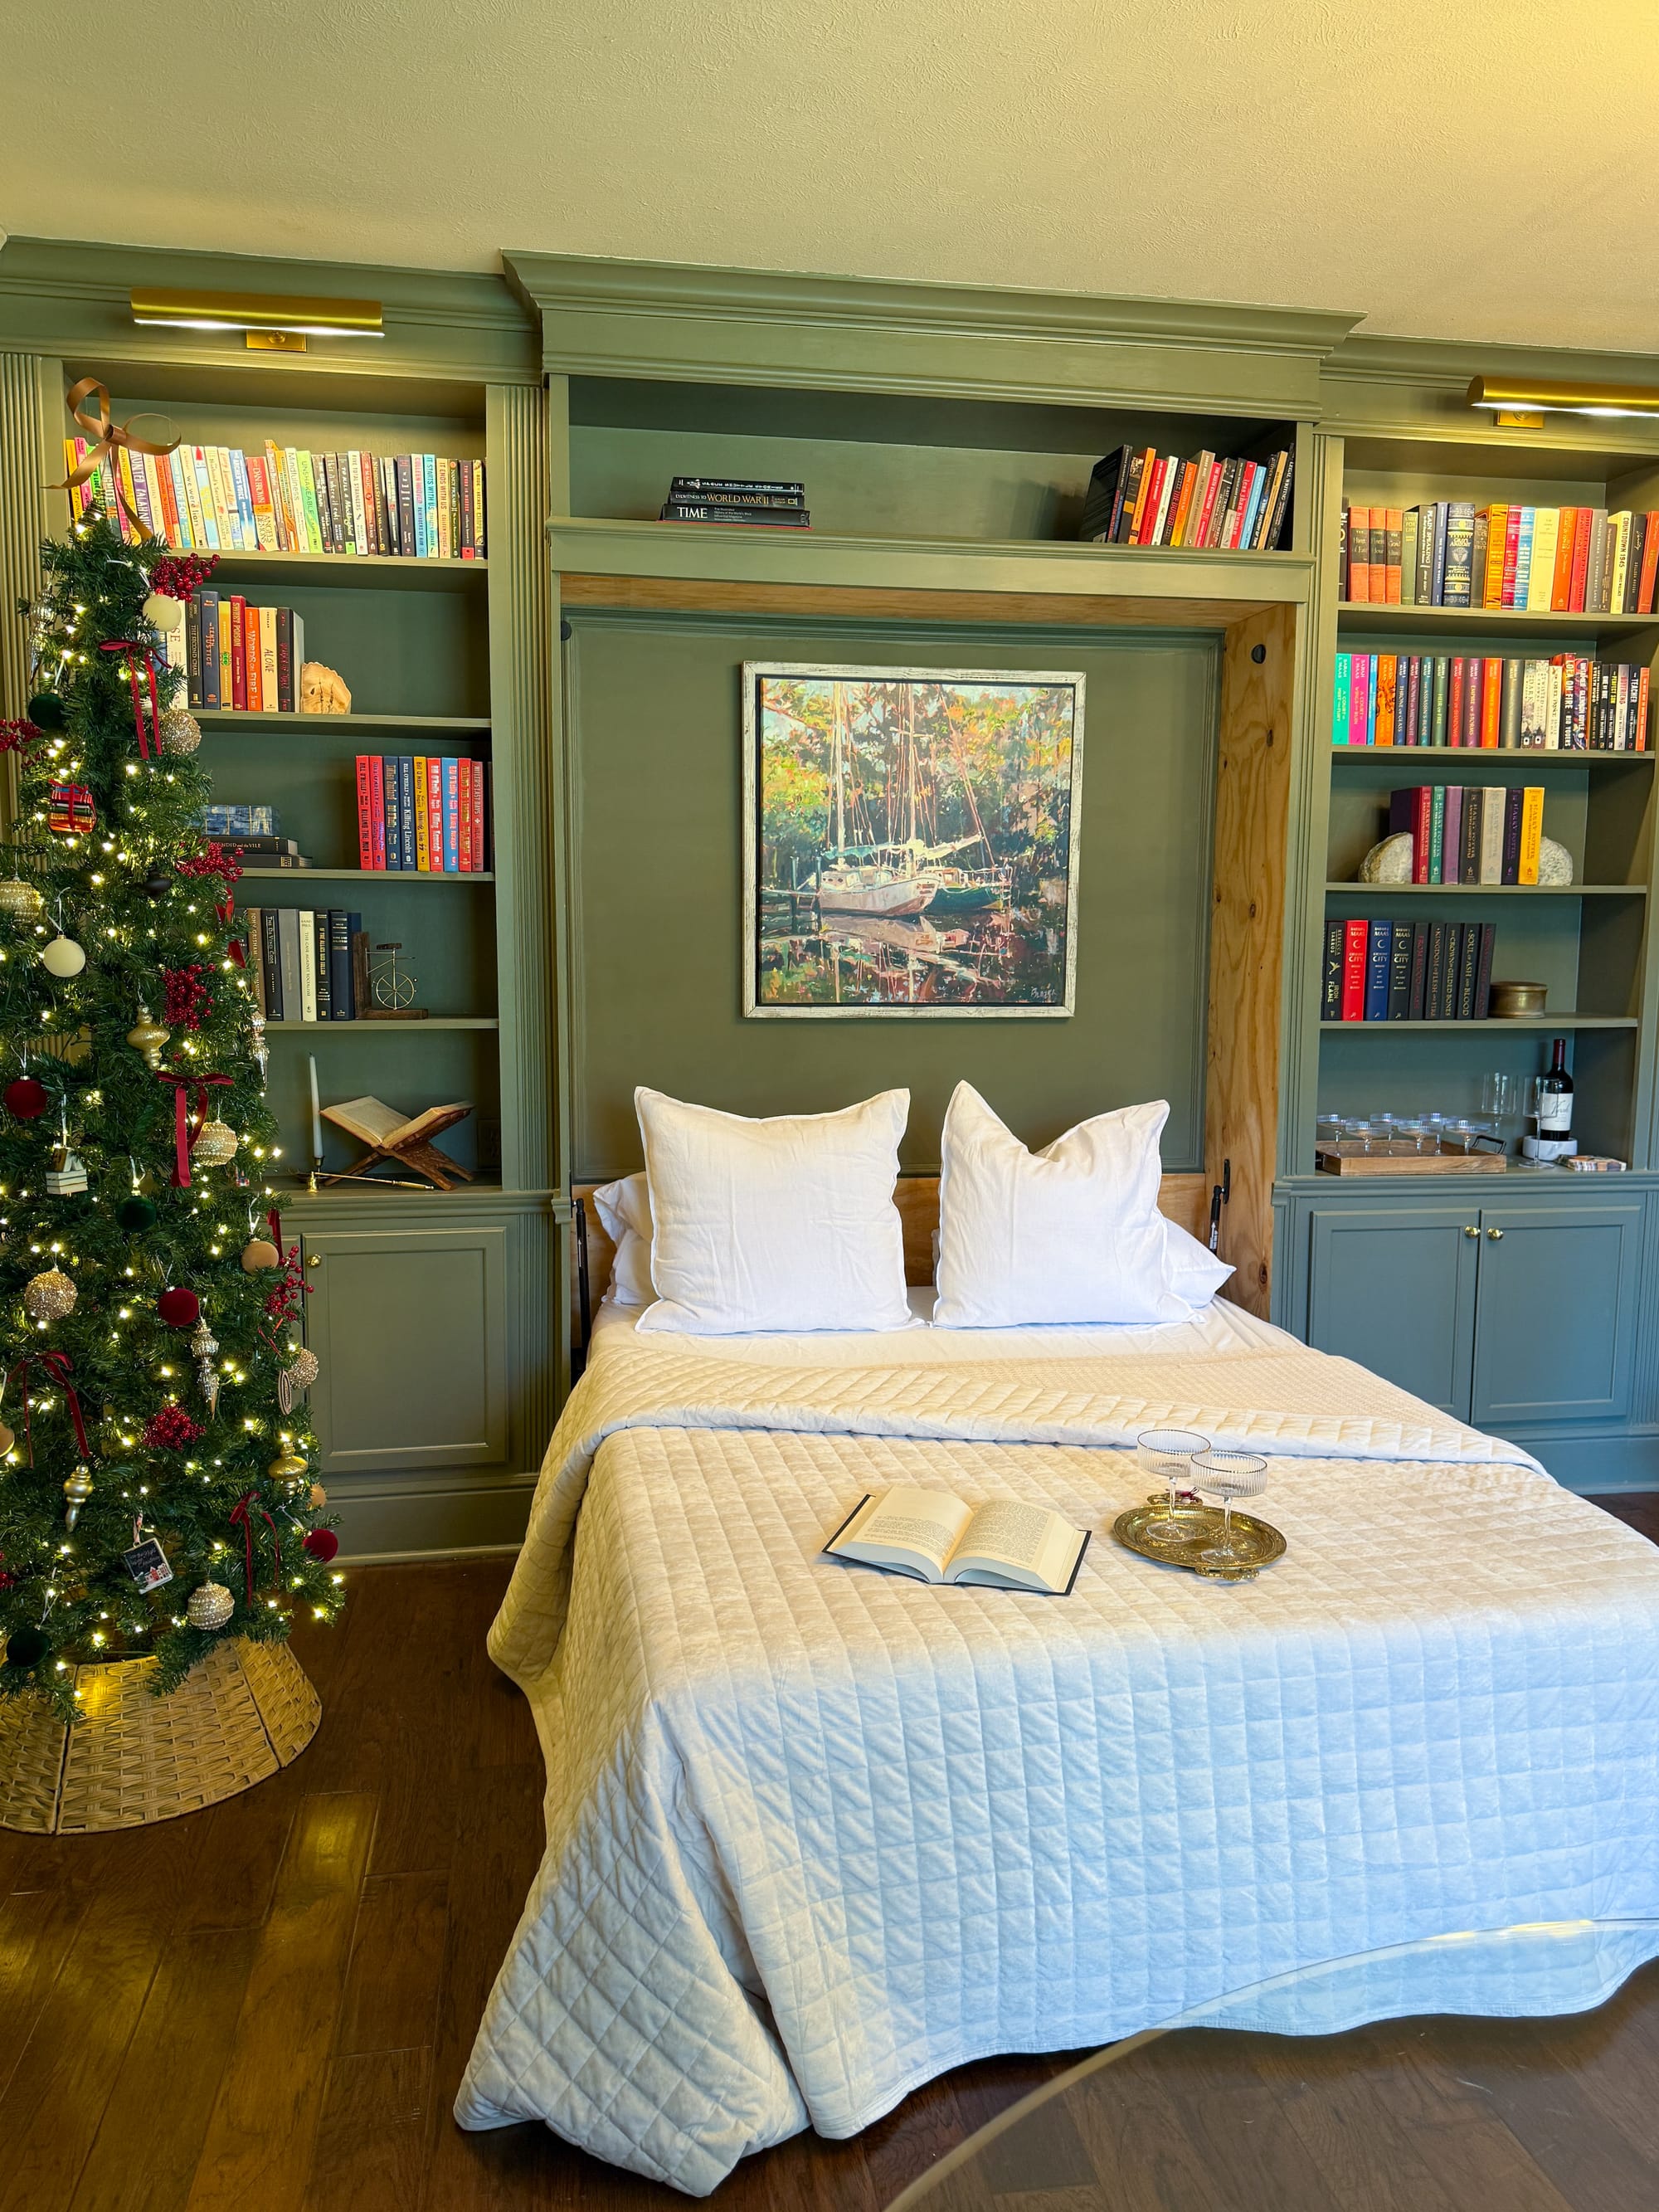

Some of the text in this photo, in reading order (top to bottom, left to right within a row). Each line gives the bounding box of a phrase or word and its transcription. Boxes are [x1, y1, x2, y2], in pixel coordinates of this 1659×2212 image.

[103, 474, 116, 502] IGNITE
[287, 452, 300, 501] Mindfulness
[301, 460, 314, 515] UNSHAKEABLE
[426, 464, 435, 485] STARTS
[1280, 461, 1294, 500] LEGAL WRITING
[176, 484, 187, 519] LIVE FOR
[186, 475, 202, 527] we were liars
[254, 480, 265, 504] BROWN
[353, 483, 362, 511] STRANGERS
[428, 502, 435, 510] US
[440, 501, 447, 510] US
[707, 493, 741, 504] WORLD
[742, 495, 762, 504] WAR
[761, 496, 769, 505] II
[343, 499, 354, 537] Mockingbird
[677, 506, 708, 519] TIME
[264, 515, 274, 543] ANGELS
[1620, 517, 1630, 553] COUNTDOWN
[232, 602, 241, 647] SWEET POISON
[205, 635, 213, 668] JUSTICE
[247, 630, 256, 662] WORDS
[264, 648, 275, 674] ALONE
[249, 672, 258, 694] FIRE
[1565, 680, 1574, 691] ON
[1630, 678, 1639, 704] TEACHER
[1564, 693, 1574, 709] FIRE
[473, 766, 481, 788] HITLER'S
[360, 808, 369, 829] KILLING
[401, 809, 413, 854] Killing Lincoln
[431, 812, 441, 852] Killing Kennedy
[1433, 929, 1441, 967] KINGDOM
[1447, 936, 1456, 963] CROWN
[1431, 971, 1439, 993] FLESH
[1445, 993, 1453, 1016] BONES
[1462, 987, 1471, 1016] BLOOD
